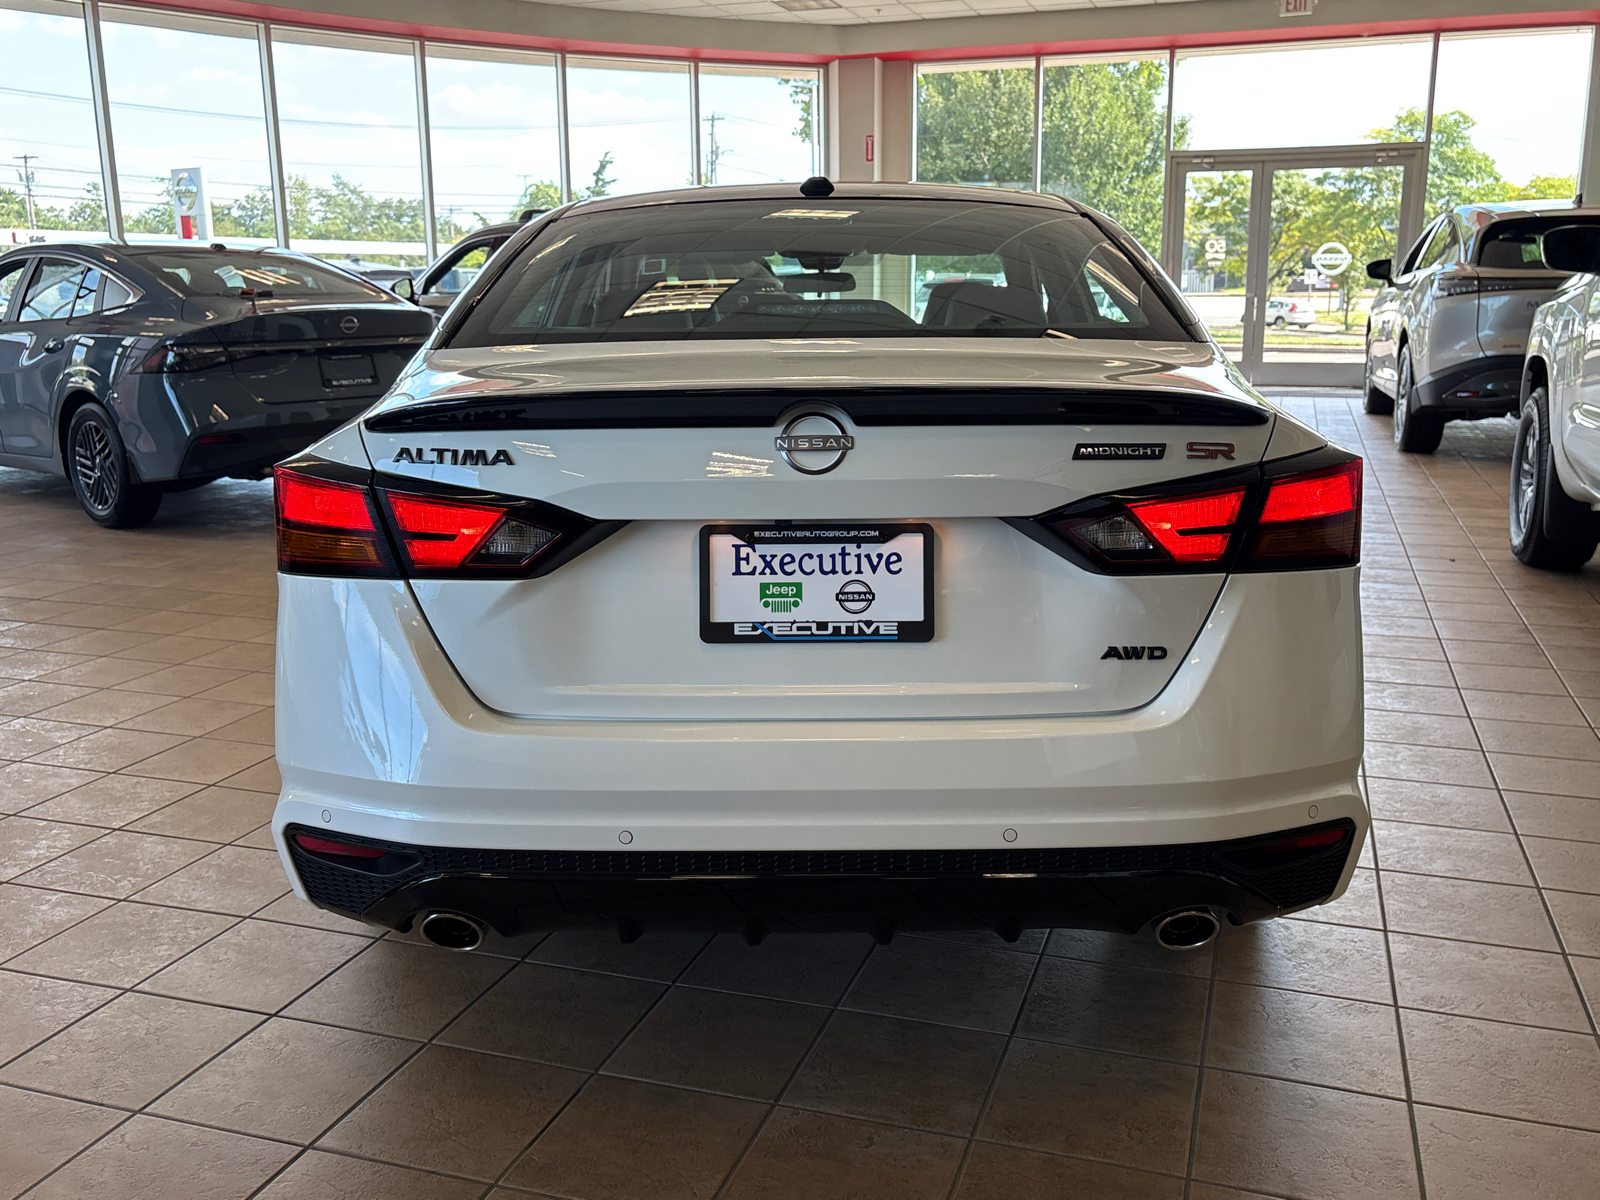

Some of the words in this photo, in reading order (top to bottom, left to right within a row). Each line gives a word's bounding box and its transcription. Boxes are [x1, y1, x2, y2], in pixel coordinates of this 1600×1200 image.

[776, 438, 852, 448] NISSAN
[392, 447, 516, 466] ALTIMA
[1079, 446, 1162, 455] MIDNIGHT
[1186, 441, 1236, 460] SR
[731, 543, 903, 576] Executive
[766, 584, 797, 596] Jeep
[733, 622, 898, 635] EXECUTIVE
[1100, 646, 1168, 660] AWD
